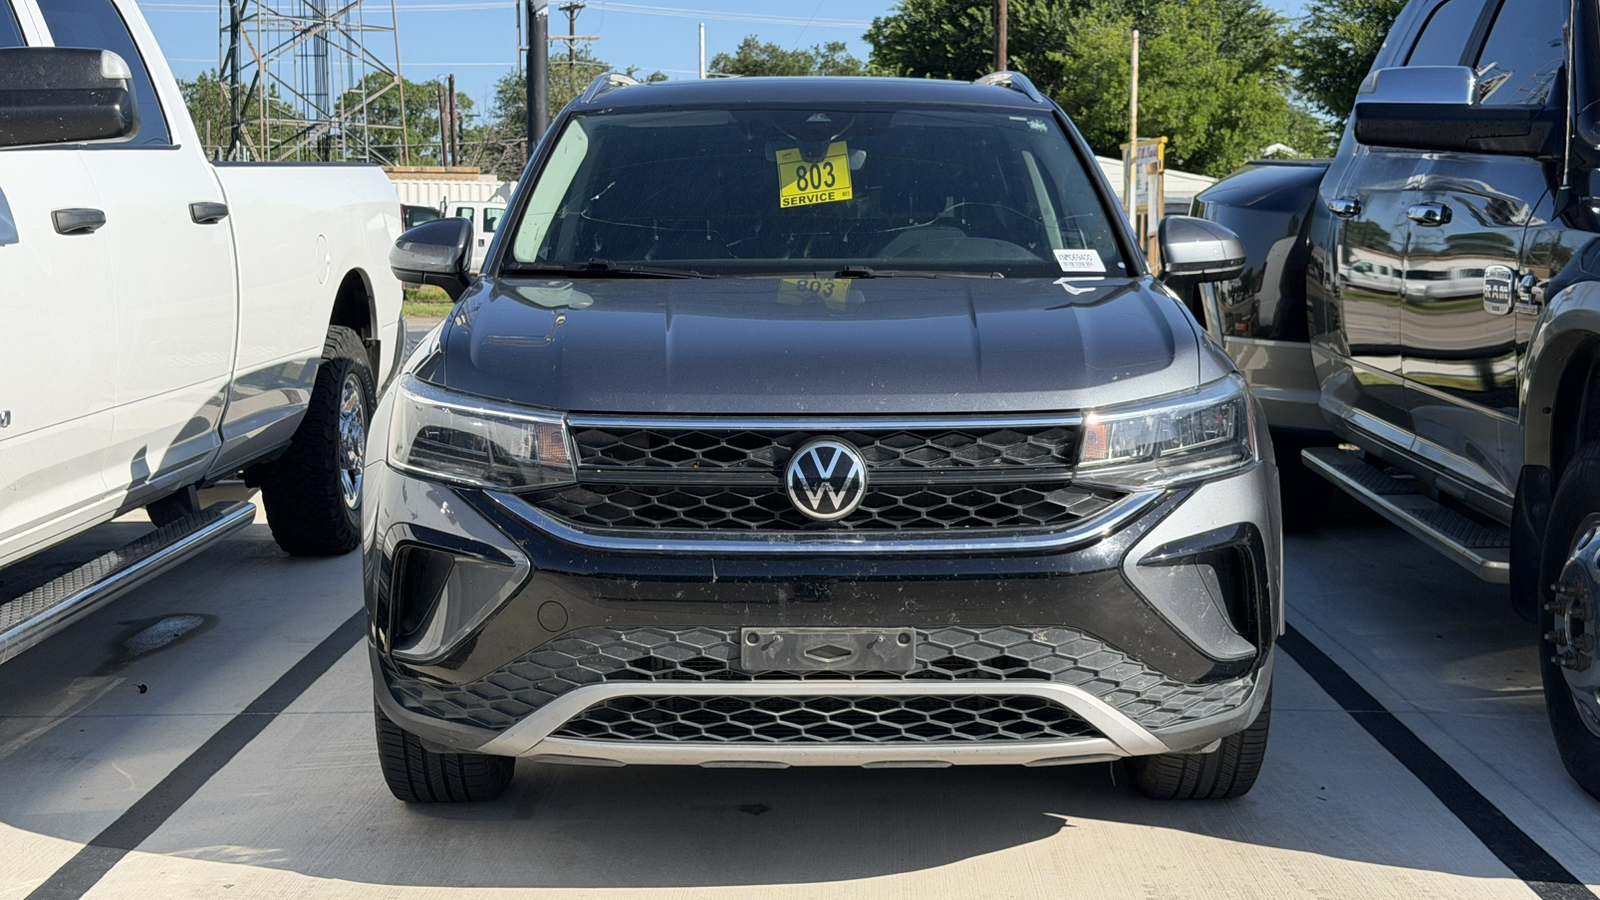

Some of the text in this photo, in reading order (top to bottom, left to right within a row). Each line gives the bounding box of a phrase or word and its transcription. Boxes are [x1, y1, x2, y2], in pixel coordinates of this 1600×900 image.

[796, 162, 836, 192] 803
[782, 191, 835, 207] SERVICE
[1485, 284, 1508, 300] RAM
[791, 446, 861, 512] VW
